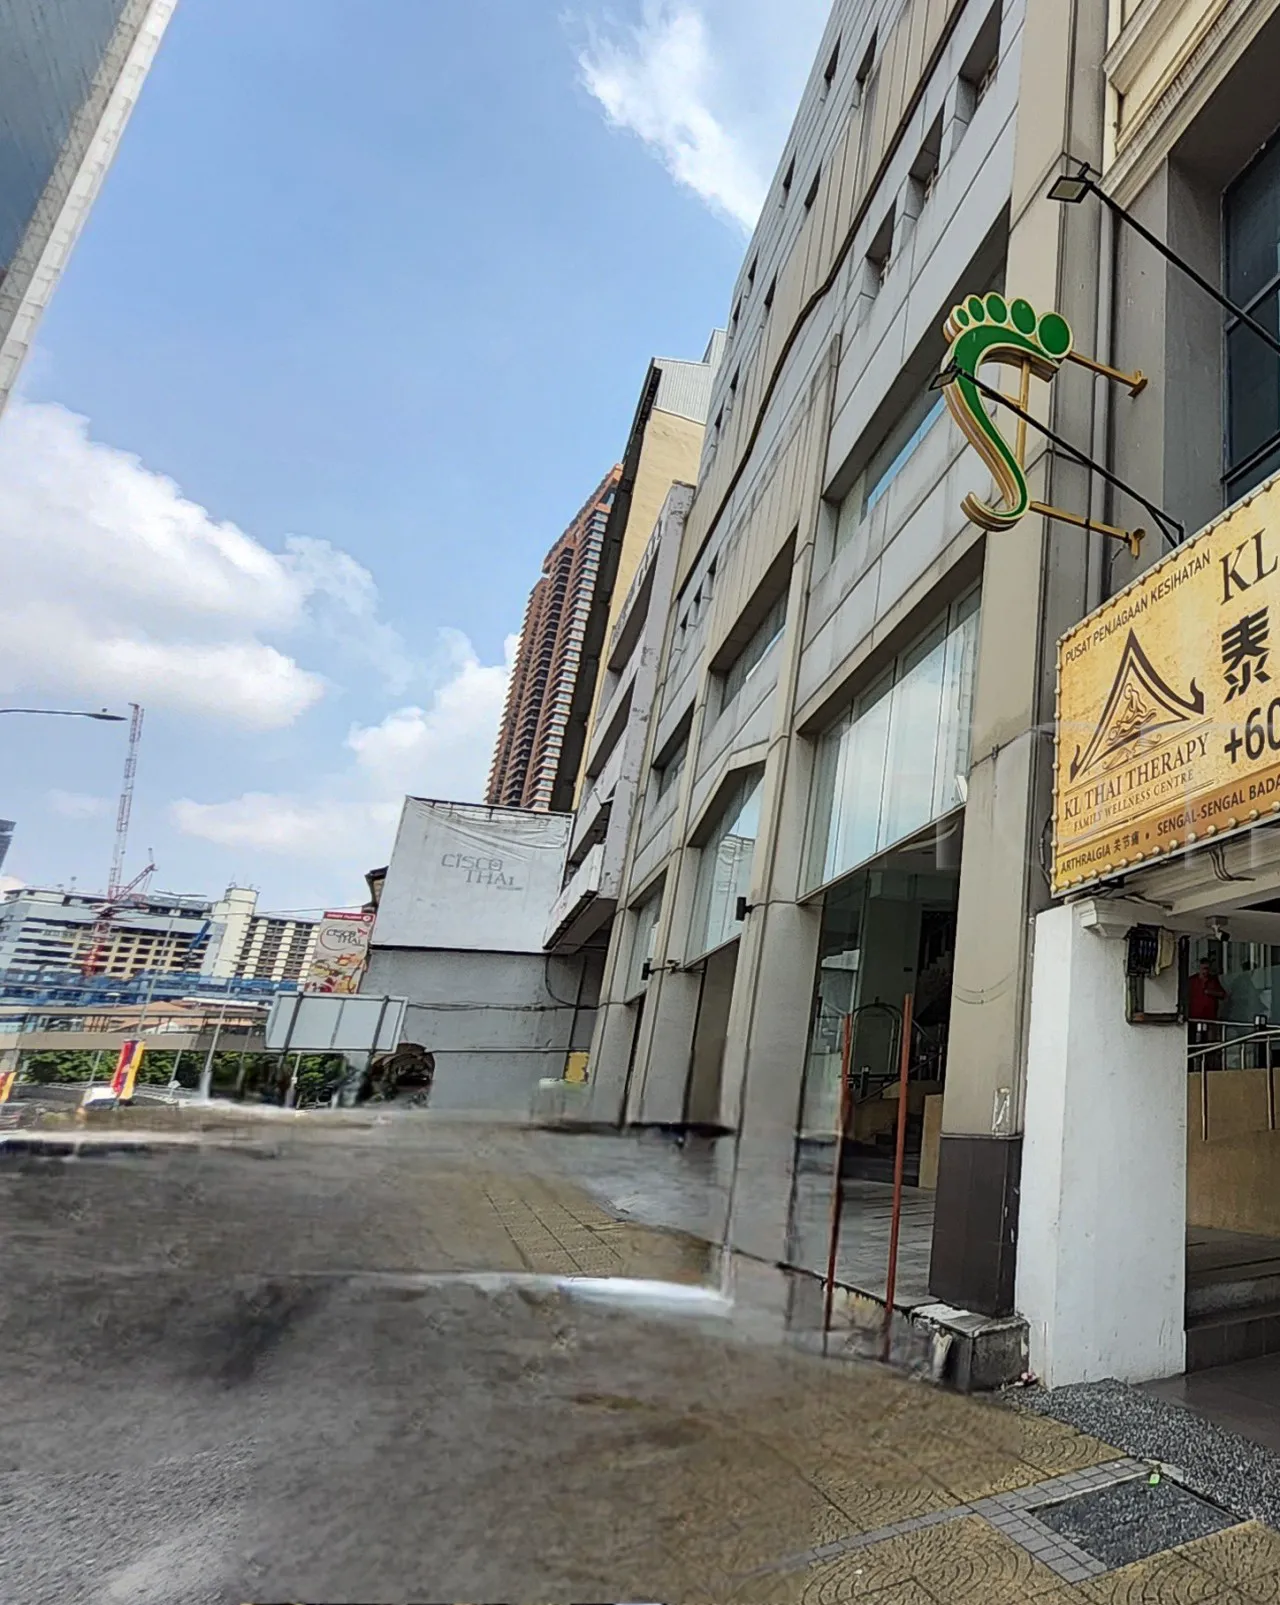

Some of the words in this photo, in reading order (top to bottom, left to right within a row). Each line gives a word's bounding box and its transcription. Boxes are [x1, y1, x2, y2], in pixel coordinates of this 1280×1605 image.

[1065, 636, 1092, 665] PUSAT
[1093, 595, 1148, 646] PENJAGAAN
[1150, 549, 1211, 602] KESIHATAN
[1219, 528, 1278, 605] KL
[1064, 798, 1081, 821] KL
[1085, 776, 1122, 811] THAI
[1125, 732, 1210, 791] THERAPY
[1073, 809, 1103, 832] FAMILY
[1104, 792, 1151, 818] WELLNESS
[1153, 769, 1194, 796] CENTRE
[1060, 844, 1111, 875] ARTHRALGIA
[1156, 789, 1245, 837] SENGAL-SENGAL
